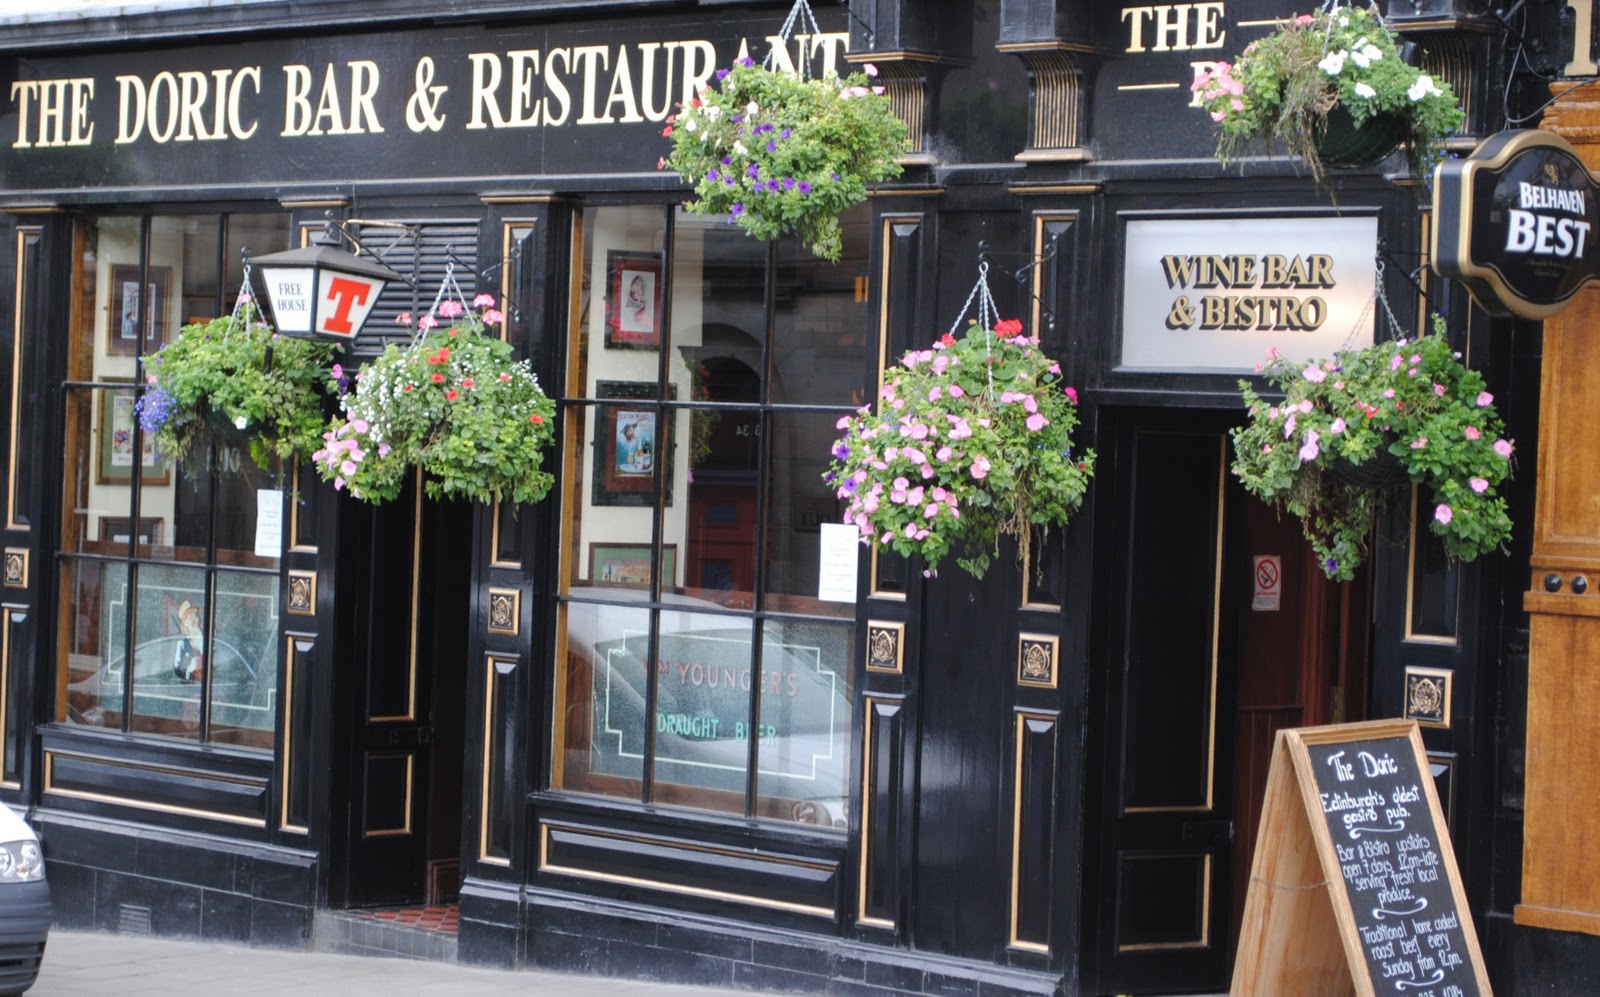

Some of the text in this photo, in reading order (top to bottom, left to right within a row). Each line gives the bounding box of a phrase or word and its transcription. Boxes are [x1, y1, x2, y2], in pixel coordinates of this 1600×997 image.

[1121, 2, 1225, 52] THE
[11, 77, 95, 149] THE
[114, 66, 261, 145] DORIC
[280, 60, 385, 137] BAR
[405, 55, 448, 133] &
[1519, 182, 1585, 215] BELHAVEN
[1505, 209, 1591, 258] BEST
[1160, 254, 1337, 289] WINE BAR
[277, 299, 308, 312] HOUSE
[278, 283, 303, 296] FREE
[323, 276, 372, 335] T
[1165, 295, 1328, 332] & BISTRO
[657, 712, 776, 746] DRAUGHT BER
[1327, 750, 1398, 782] The Doric
[1320, 784, 1420, 813] Edinburgh's oldest
[1343, 803, 1411, 829] gastro pub.
[1336, 844, 1355, 861] Bar
[1363, 839, 1390, 858] Bistro
[1396, 833, 1430, 858] upstairs
[1343, 863, 1363, 884] open
[1361, 859, 1370, 875] 7
[1355, 866, 1438, 893] serving fresh local
[1359, 911, 1458, 944] Traditional home cooked
[1371, 933, 1451, 960] roast beef every
[1382, 958, 1415, 980] Sunday
[1417, 954, 1436, 977] from
